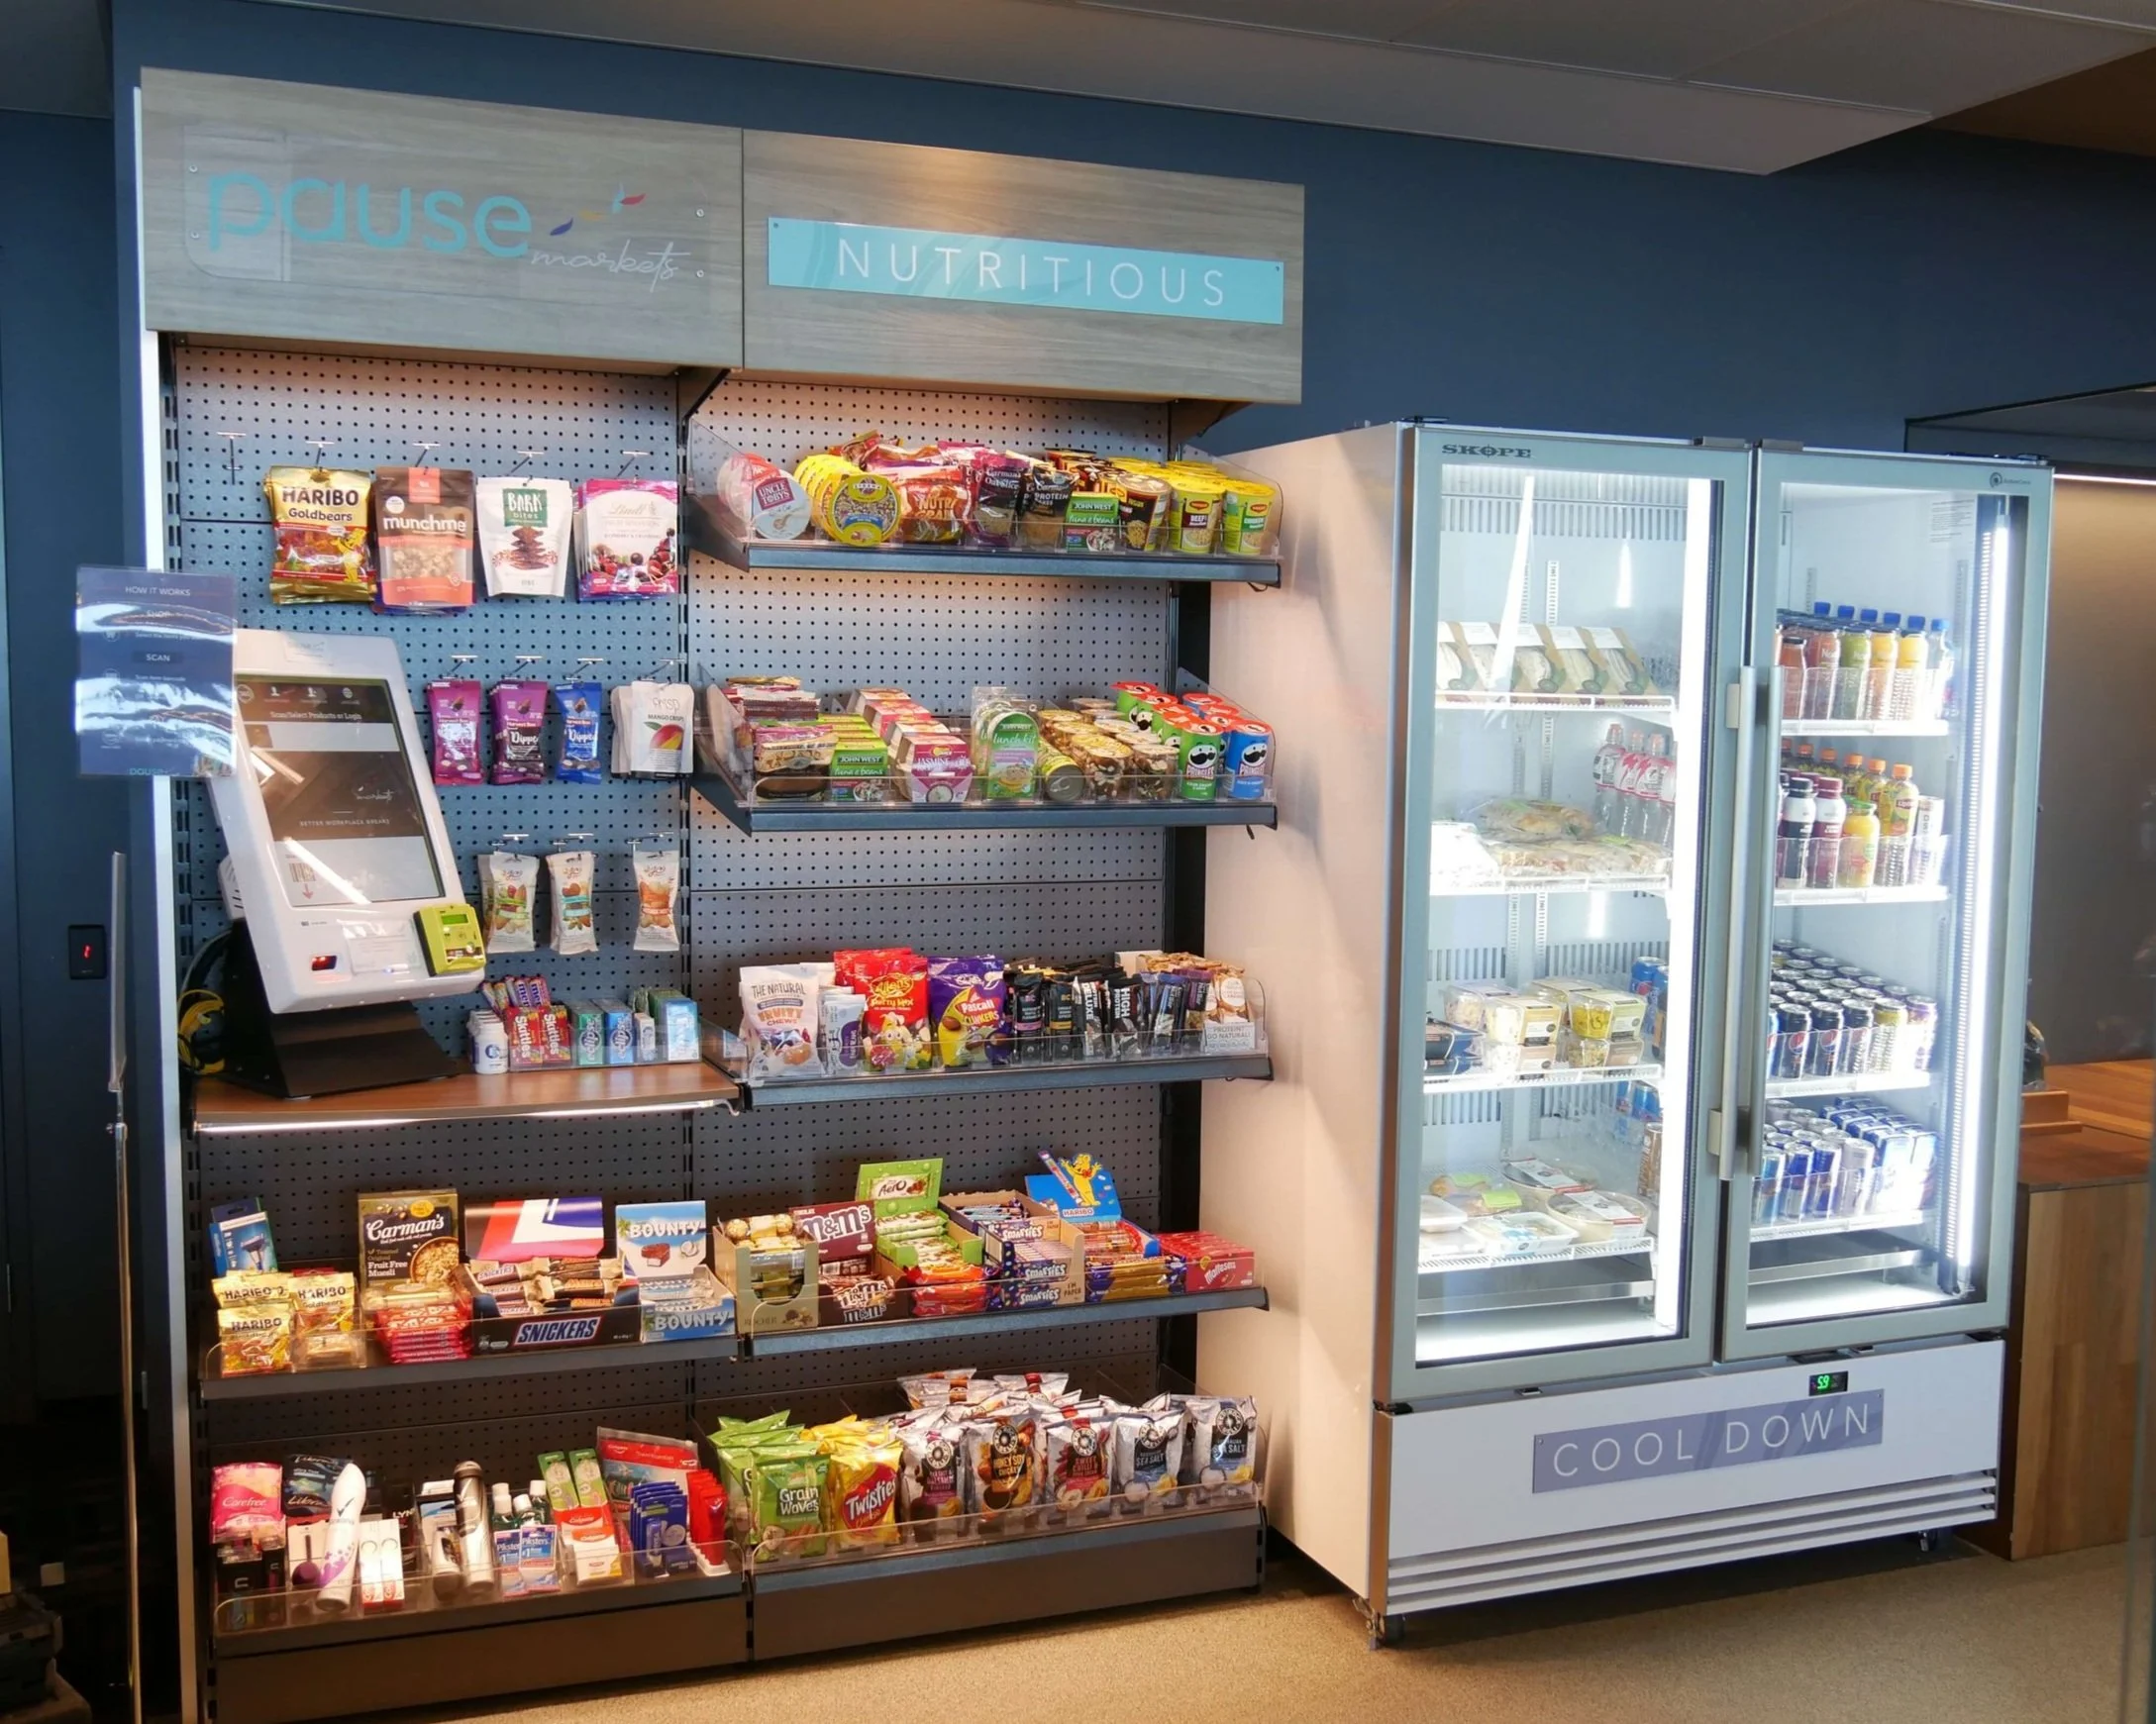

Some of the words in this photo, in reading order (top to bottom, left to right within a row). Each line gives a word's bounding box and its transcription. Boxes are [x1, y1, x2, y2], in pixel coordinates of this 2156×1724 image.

[207, 170, 533, 259] pause
[531, 240, 691, 293] markets
[838, 238, 1225, 307] NUTRITIOUS
[1441, 444, 1532, 458] SKOPE
[282, 486, 359, 506] HARIBO
[758, 482, 786, 496] UNCLE
[762, 491, 790, 506] TOBYS
[919, 497, 957, 510] NUTRI
[1074, 502, 1090, 511] JOHN
[1092, 502, 1112, 511] WEST
[288, 508, 353, 522] Goldbears
[512, 511, 540, 520] bites
[383, 515, 467, 532] munchme
[146, 654, 170, 662] SCAN
[752, 985, 767, 998] THE
[768, 982, 806, 996] NATURAL
[962, 1000, 995, 1013] Pascall
[1081, 982, 1094, 1021] DELUXE
[1121, 987, 1131, 1018] HIGH
[758, 1008, 803, 1022] FRUITY
[514, 1015, 528, 1059] Skittles
[544, 1013, 559, 1055] Skittles
[878, 1179, 907, 1197] Aero
[365, 1214, 445, 1241] Carman's
[629, 1220, 701, 1238] BOUNTY
[1002, 1226, 1043, 1241] SMARTIES
[367, 1268, 396, 1277] Muesli
[1025, 1265, 1067, 1279] SMARTIES
[225, 1286, 272, 1300] HARIBO
[299, 1285, 347, 1300] HARIBO
[1020, 1289, 1060, 1305] SMARTIES
[231, 1317, 282, 1332] HARIBO
[655, 1311, 730, 1331] BOUNTY
[517, 1319, 599, 1343] SNICKERS
[1553, 1427, 1694, 1478] COOL
[1724, 1402, 1871, 1455] DOWN
[1229, 1445, 1245, 1454] SALT
[1149, 1455, 1165, 1465] SALT
[222, 1496, 267, 1508] Carefree
[778, 1486, 819, 1502] Grain
[846, 1479, 896, 1521] Twisties
[779, 1499, 819, 1516] Waves
